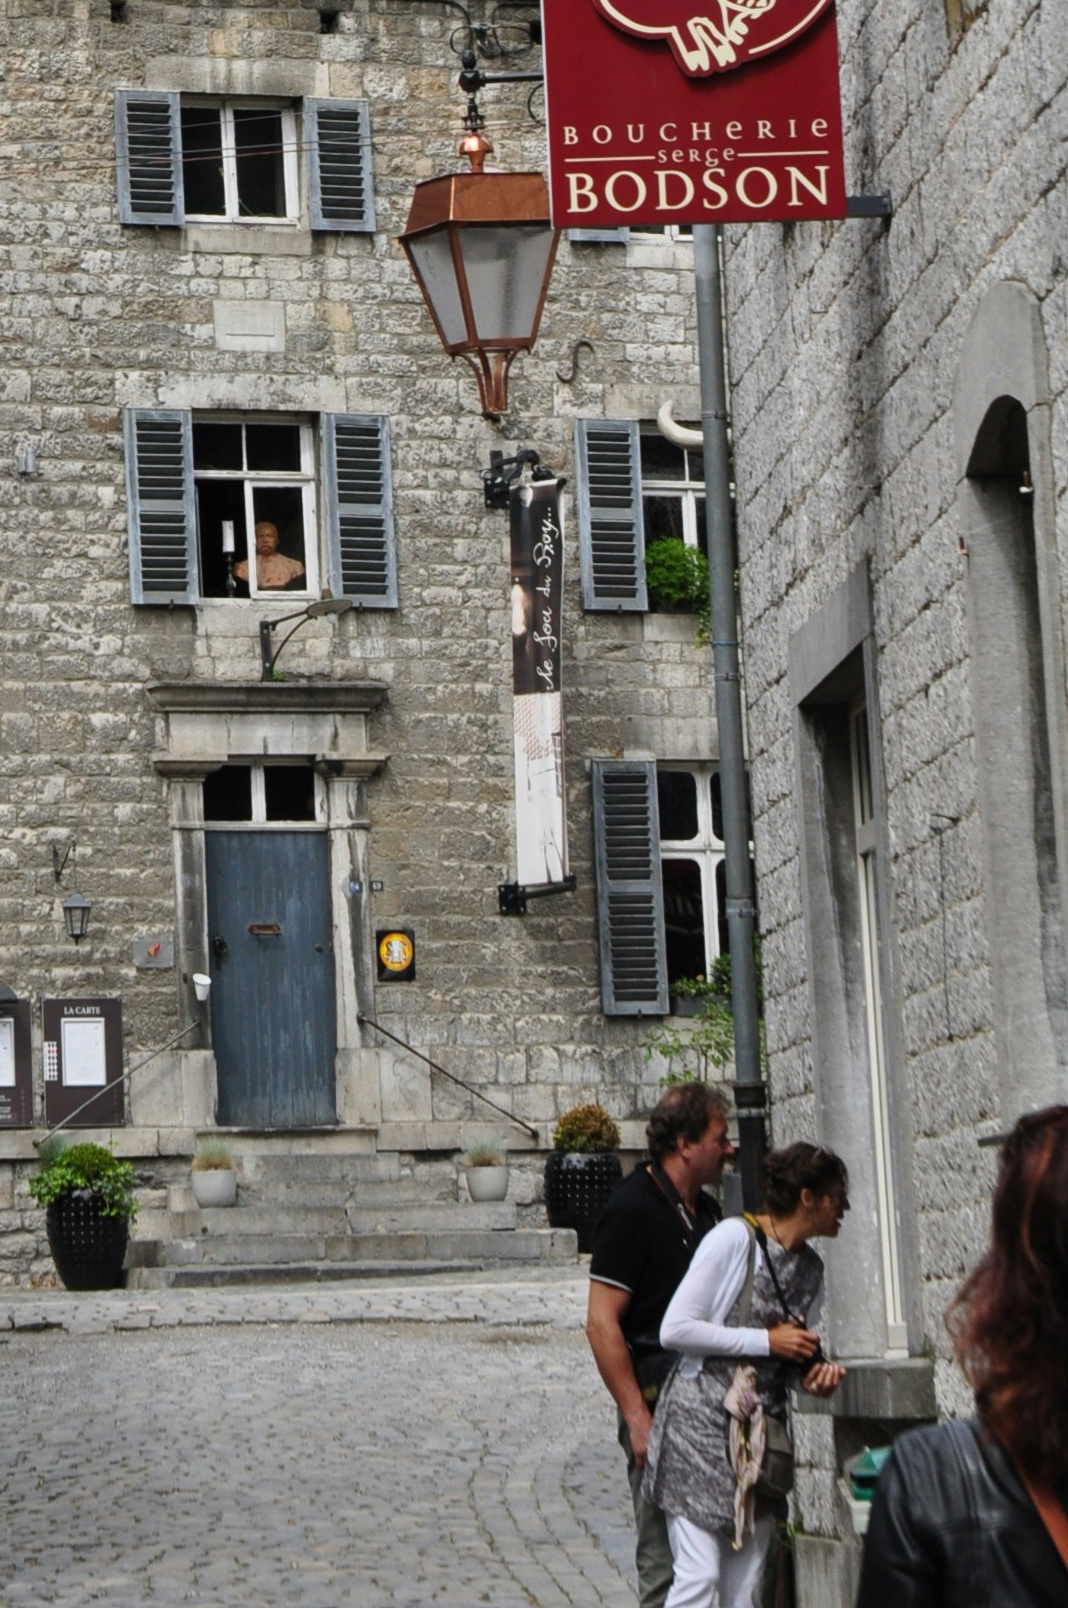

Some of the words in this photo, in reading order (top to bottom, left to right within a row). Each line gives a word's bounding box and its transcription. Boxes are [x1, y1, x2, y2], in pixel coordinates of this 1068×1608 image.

[565, 165, 831, 213] BODSON
[535, 575, 552, 598] du
[63, 1006, 75, 1015] LA
[75, 1006, 101, 1015] CARTE
